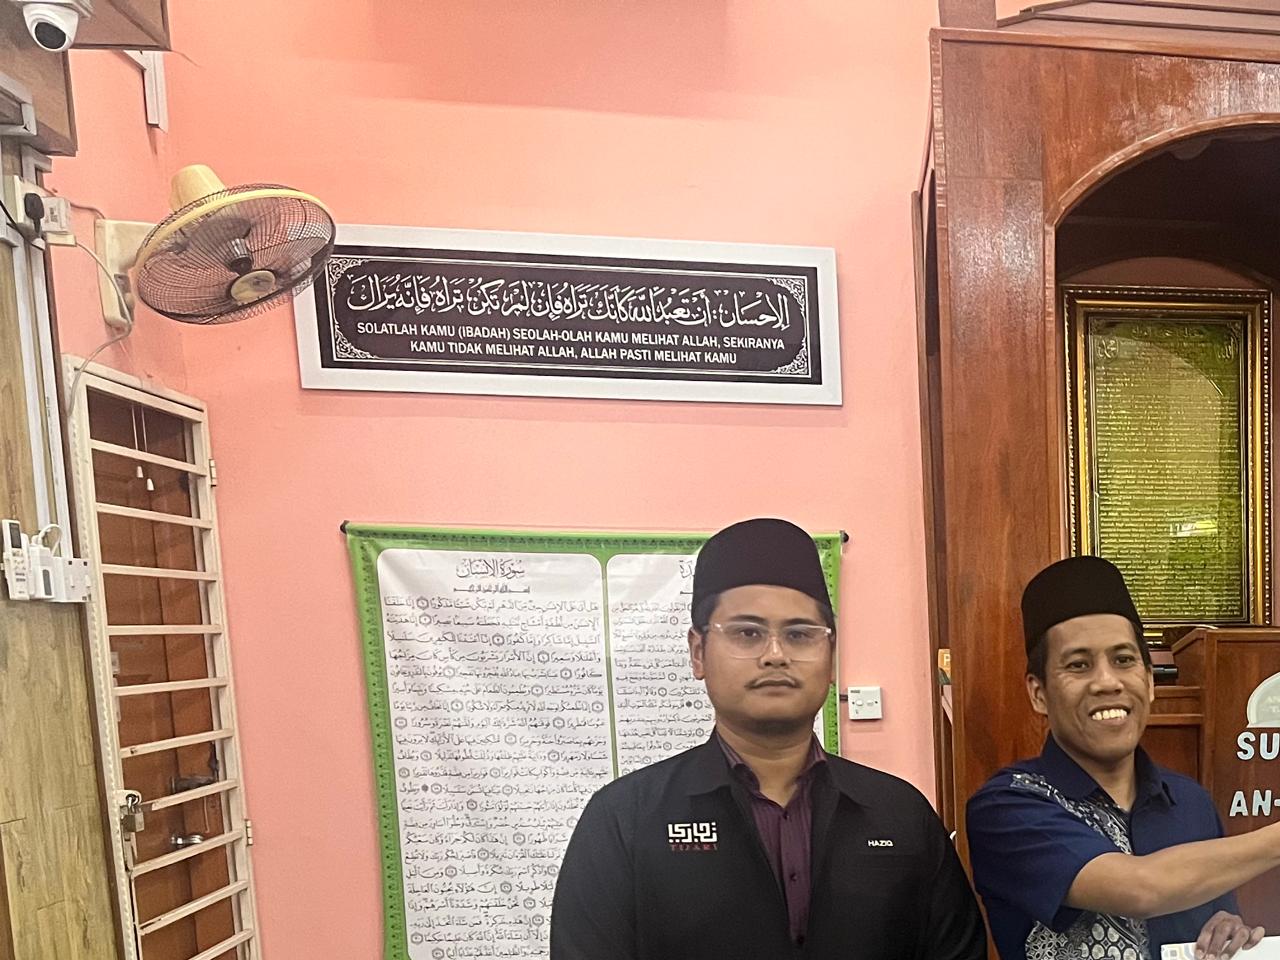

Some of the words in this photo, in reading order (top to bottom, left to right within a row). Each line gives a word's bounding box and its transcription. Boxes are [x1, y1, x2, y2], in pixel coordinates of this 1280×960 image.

[357, 322, 418, 335] SOLATLAH
[421, 325, 455, 337] KAMU
[458, 325, 511, 340] (IBADAH)
[512, 328, 592, 342] SEOLAH-OLAH
[595, 331, 628, 344] KAMU
[632, 333, 679, 346] MELIHAT
[682, 335, 721, 349] ALLAH,
[723, 336, 785, 350] SEKIRANYA
[410, 341, 445, 353] KAMU
[447, 342, 483, 355] TIDAK
[485, 344, 534, 357] MELIHAT
[537, 346, 578, 359] ALLAH,
[580, 348, 617, 360] ALLAH
[620, 350, 651, 361] PASTI
[654, 351, 701, 363] MELIHAT
[704, 352, 737, 364] KAMU
